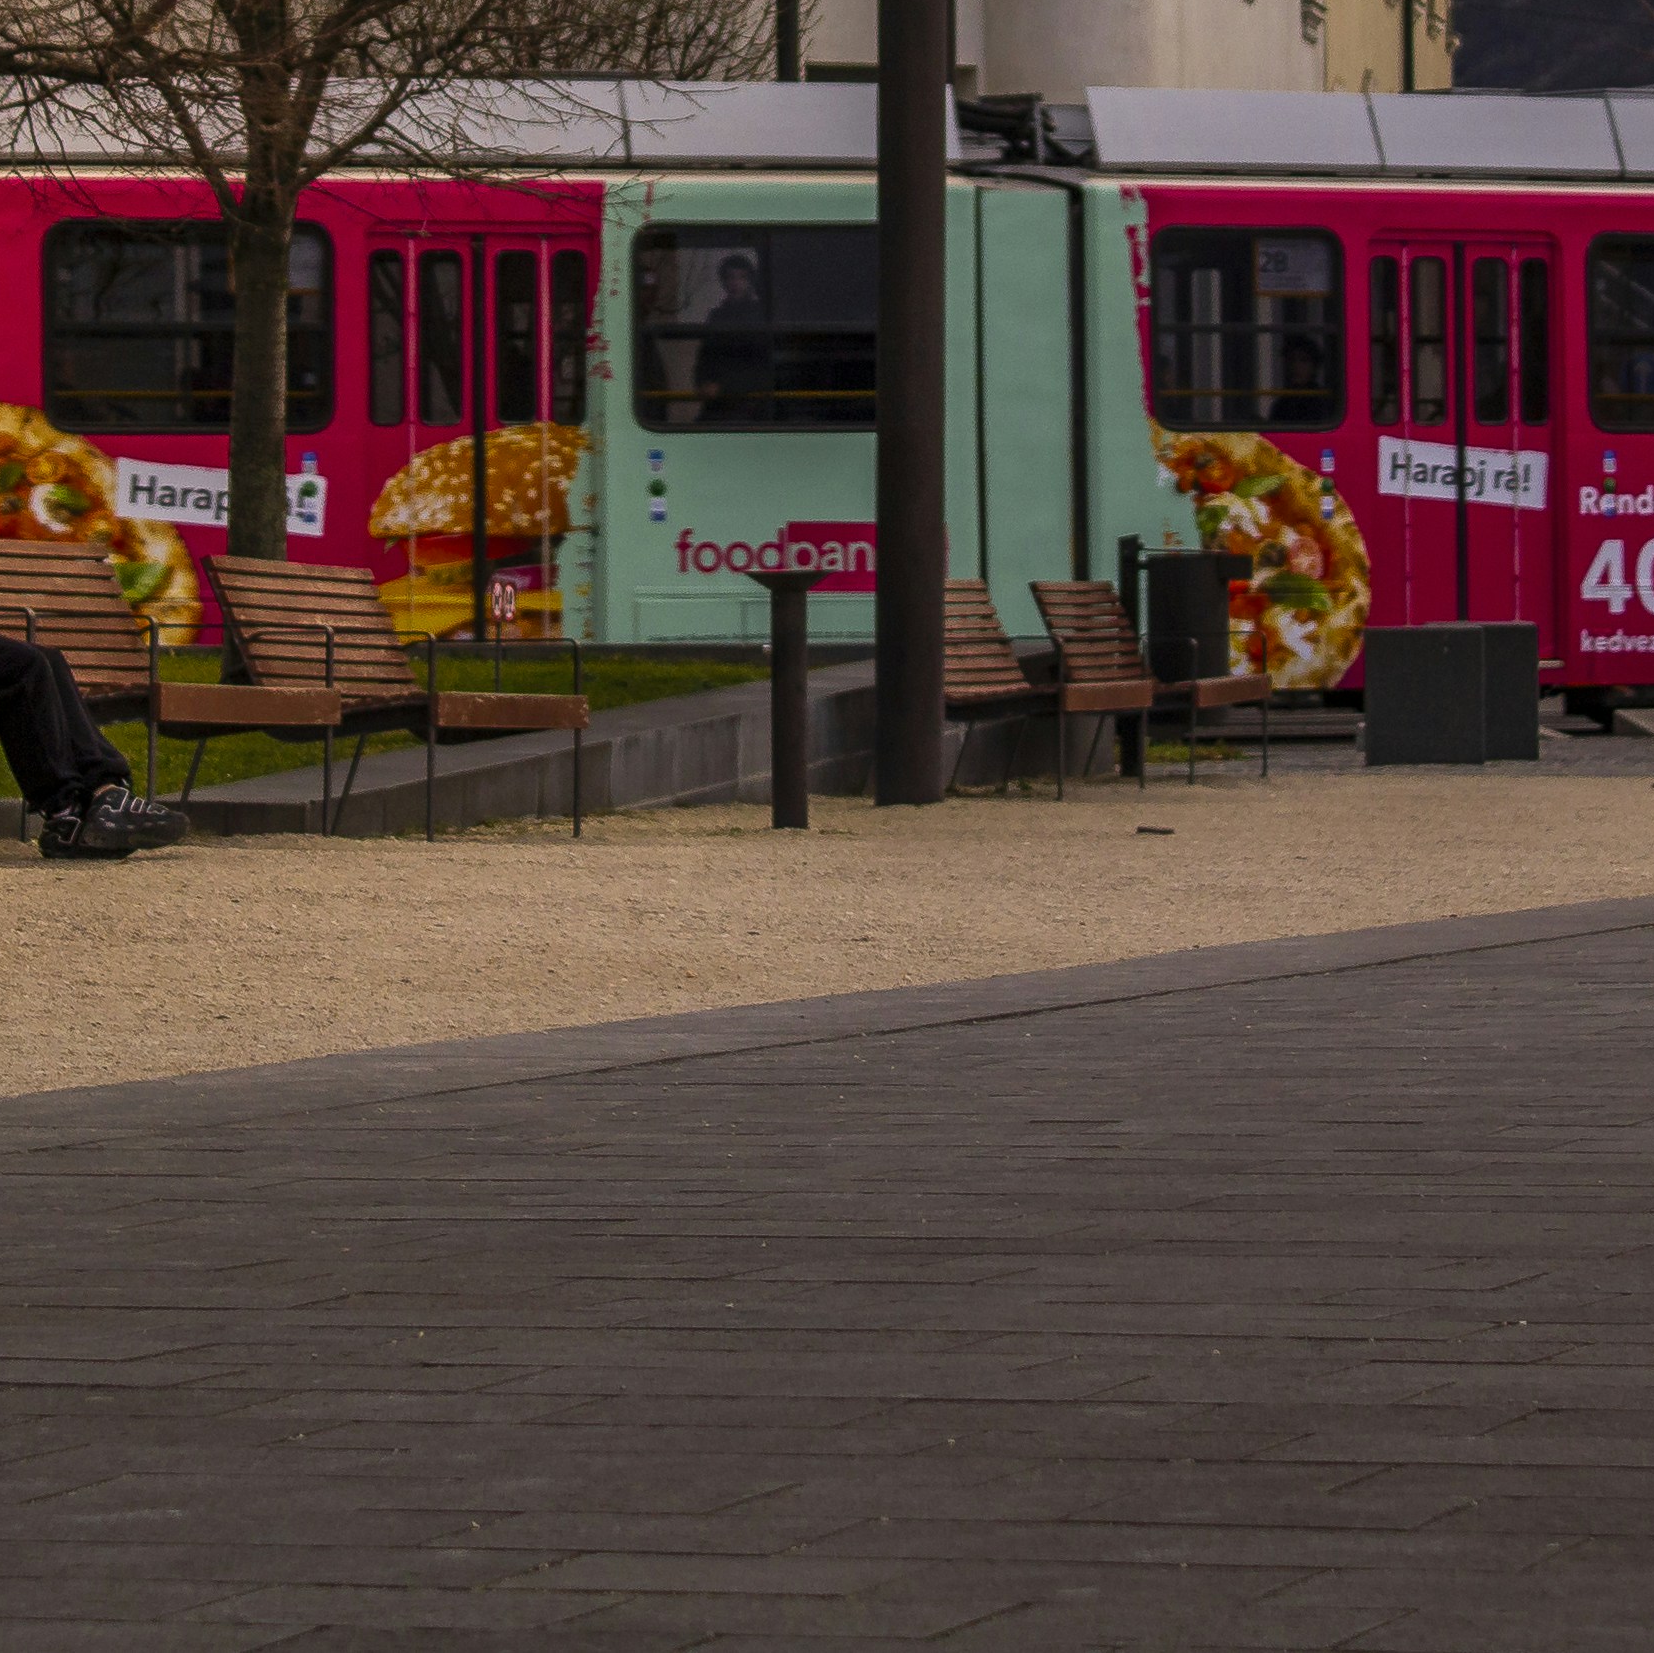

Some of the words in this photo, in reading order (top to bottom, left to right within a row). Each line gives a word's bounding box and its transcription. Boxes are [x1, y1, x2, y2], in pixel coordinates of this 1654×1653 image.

[128, 473, 230, 521] Harap
[1493, 458, 1532, 493] rá!
[674, 527, 876, 573] foodpan
